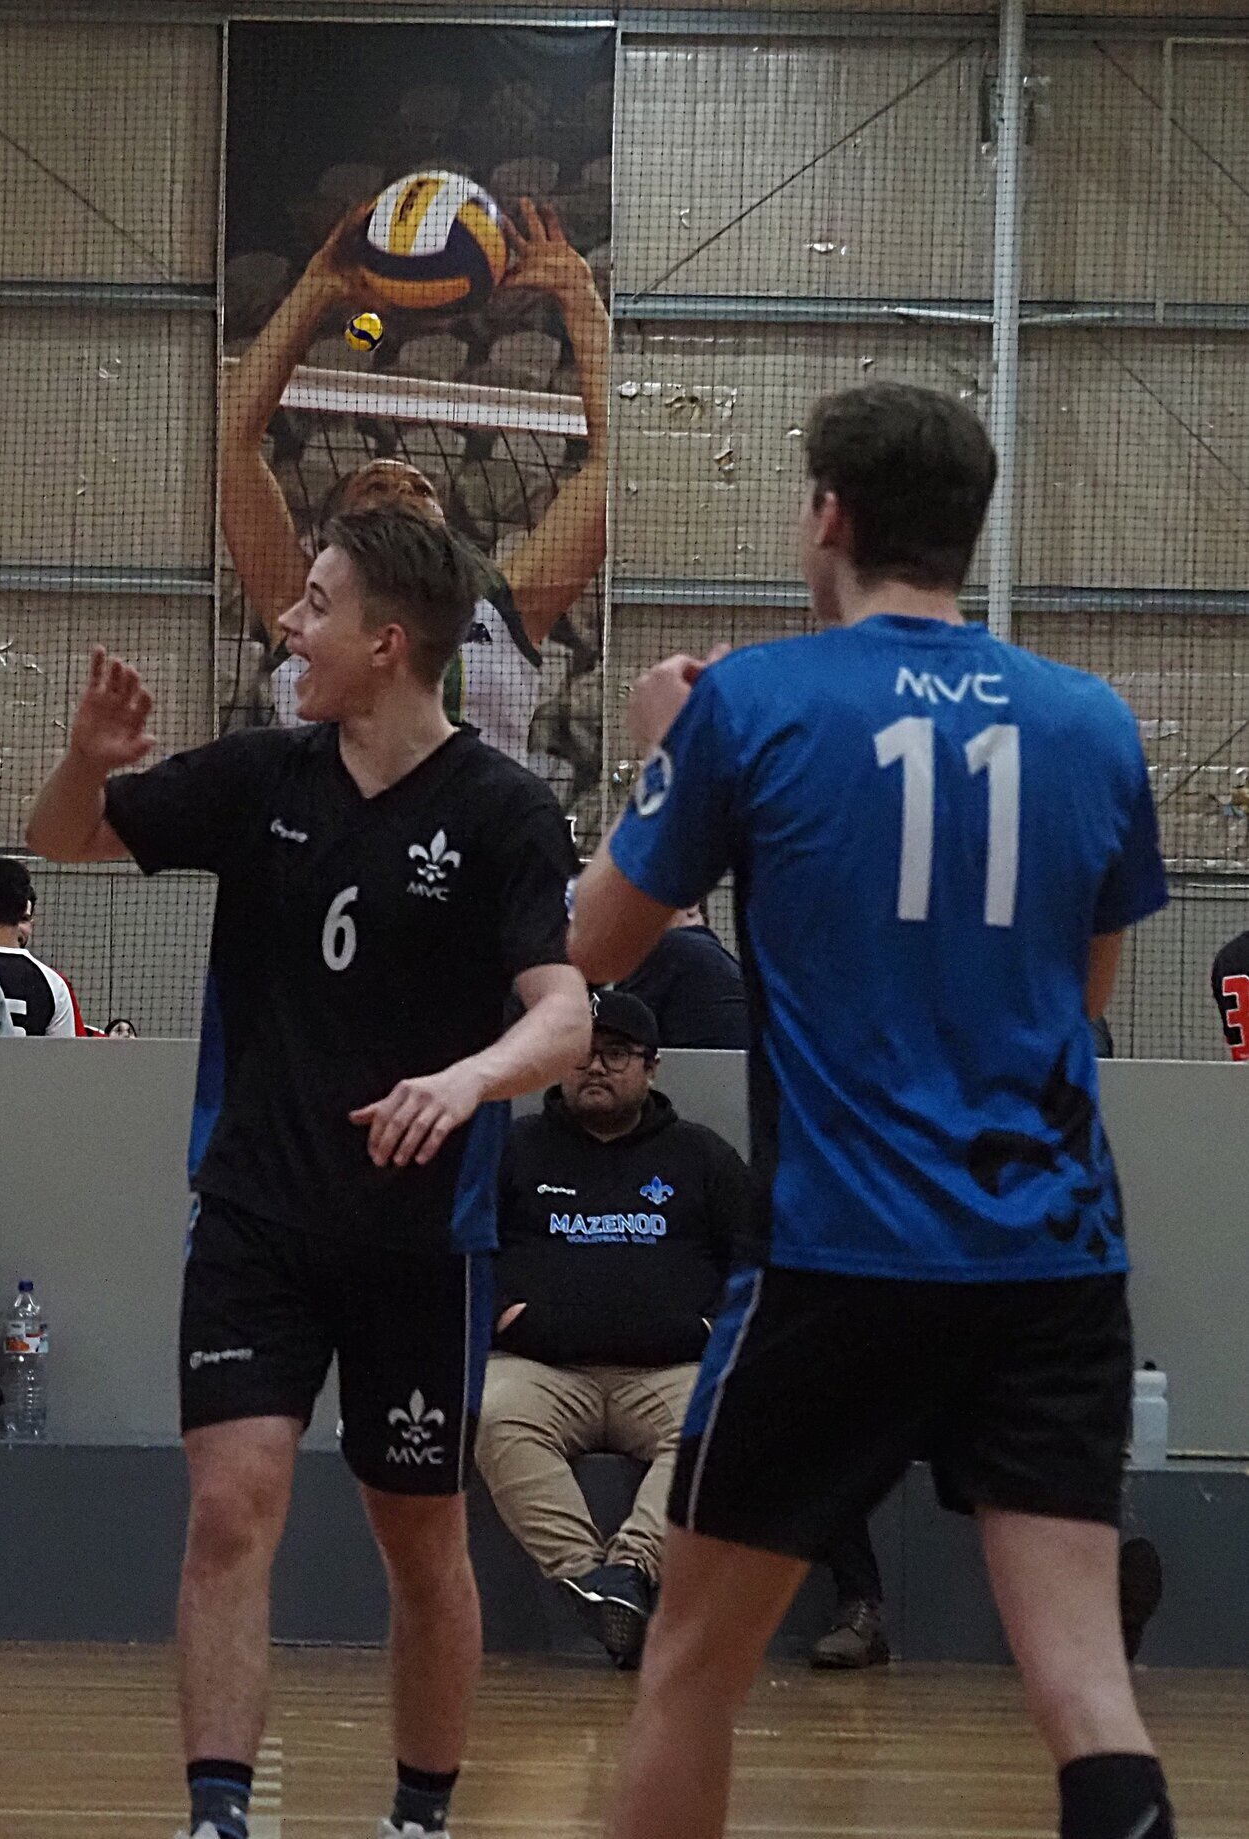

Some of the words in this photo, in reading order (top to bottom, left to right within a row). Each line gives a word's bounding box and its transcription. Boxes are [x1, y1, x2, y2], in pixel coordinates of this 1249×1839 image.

[895, 666, 1010, 705] MVC
[873, 716, 1021, 928] 11
[322, 886, 359, 971] 6
[550, 1213, 667, 1236] MAZENOD
[386, 1446, 445, 1465] MVC
